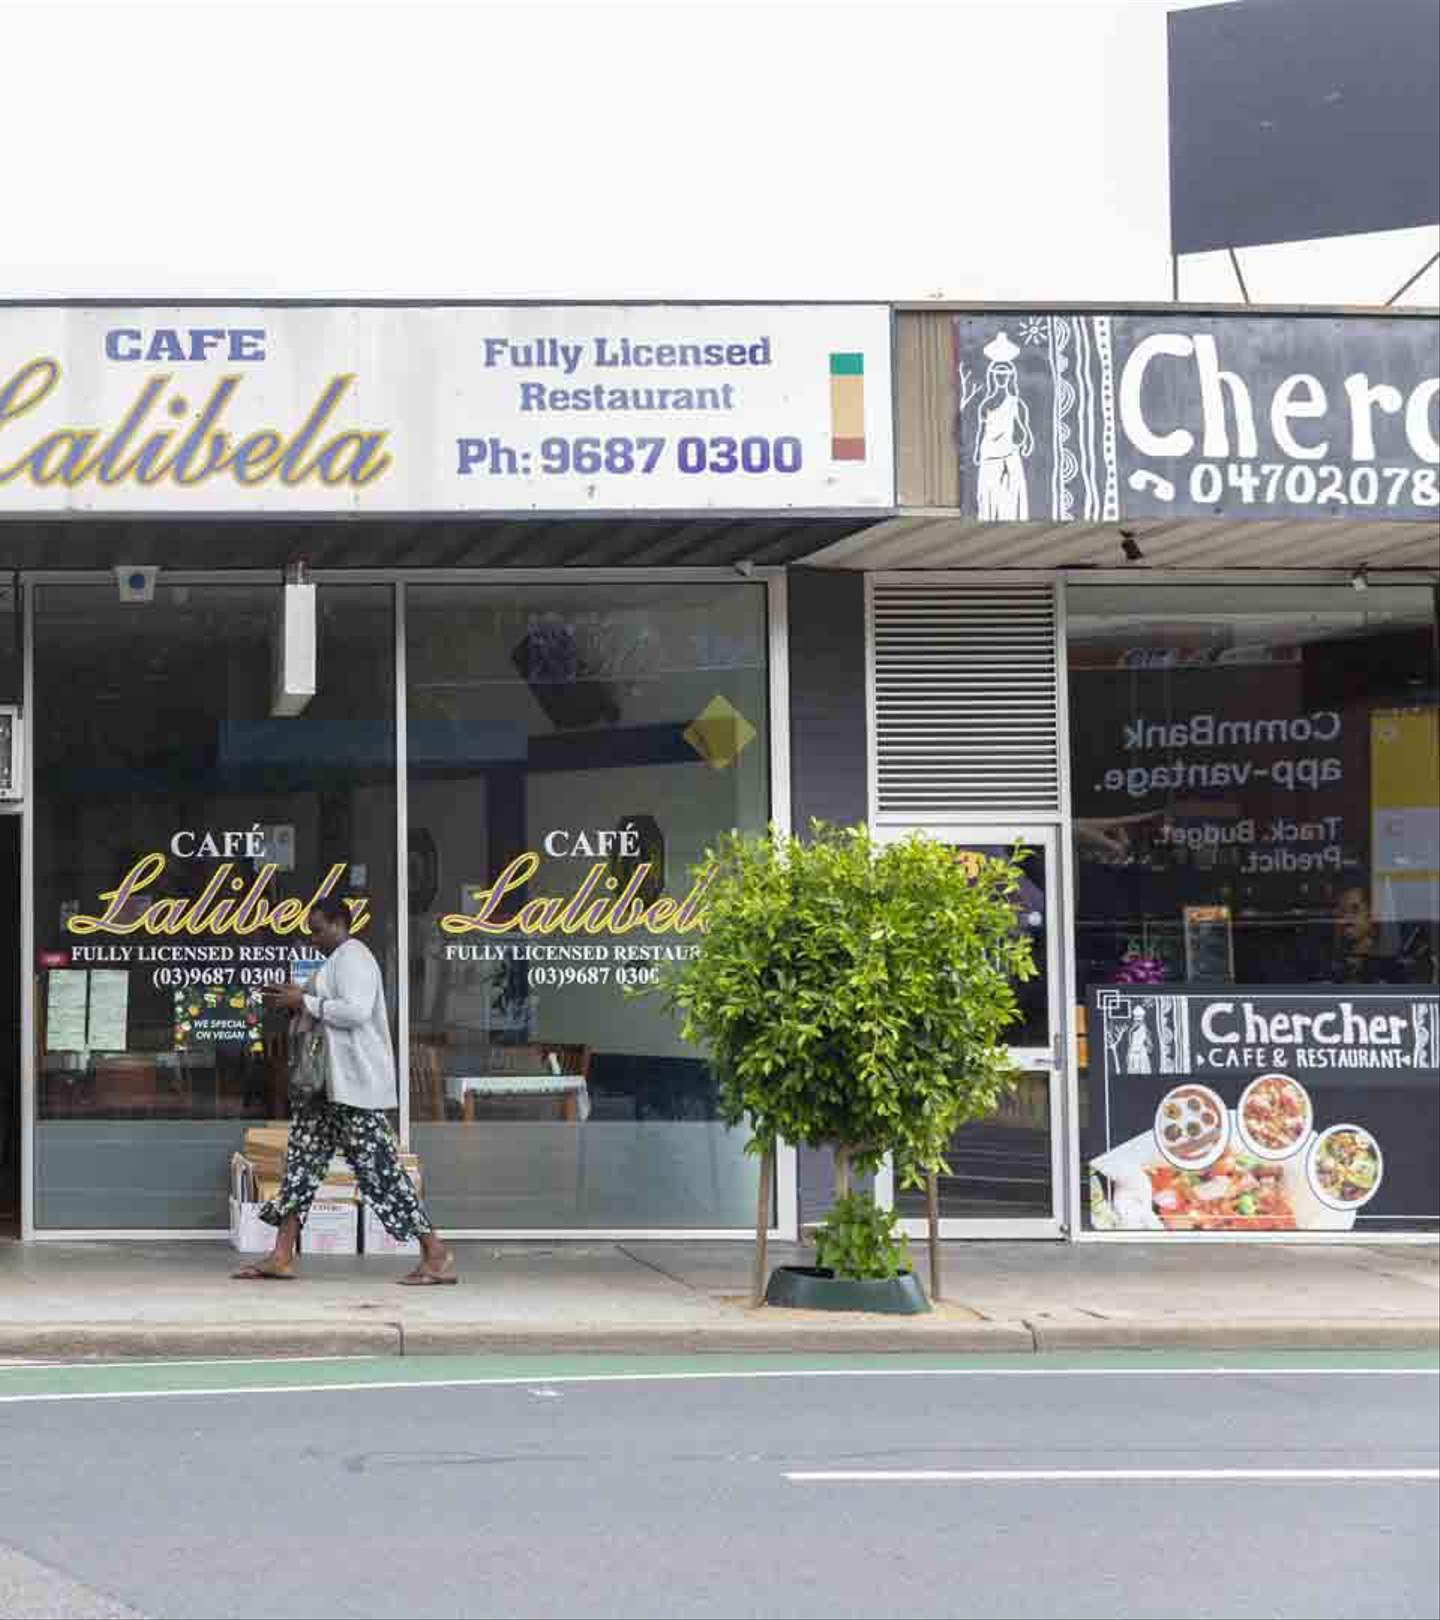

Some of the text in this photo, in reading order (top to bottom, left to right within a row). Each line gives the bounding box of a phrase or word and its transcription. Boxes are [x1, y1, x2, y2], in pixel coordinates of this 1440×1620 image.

[105, 329, 266, 361] CAFE
[483, 336, 772, 375] Fully Licensed
[519, 382, 735, 412] Restaurant
[456, 436, 803, 475] Ph: 9687 0300
[1189, 464, 1440, 506] 04702078
[170, 823, 266, 858] CAFÉ
[544, 822, 640, 857] CAFÉ
[441, 852, 720, 934] Lalibel
[72, 946, 133, 962] FULLY
[138, 946, 234, 962] LICENSED
[445, 945, 508, 961] FULLY
[512, 945, 608, 961] LICENSED
[153, 967, 286, 988] (03)9687 0300
[527, 966, 610, 988] (03)9687
[194, 1020, 247, 1029] WE SPECIAL
[196, 1031, 245, 1040] ON VEGAN
[1201, 1002, 1407, 1045] Chercher
[1209, 1048, 1403, 1069] CAFE & RESTAURANT
